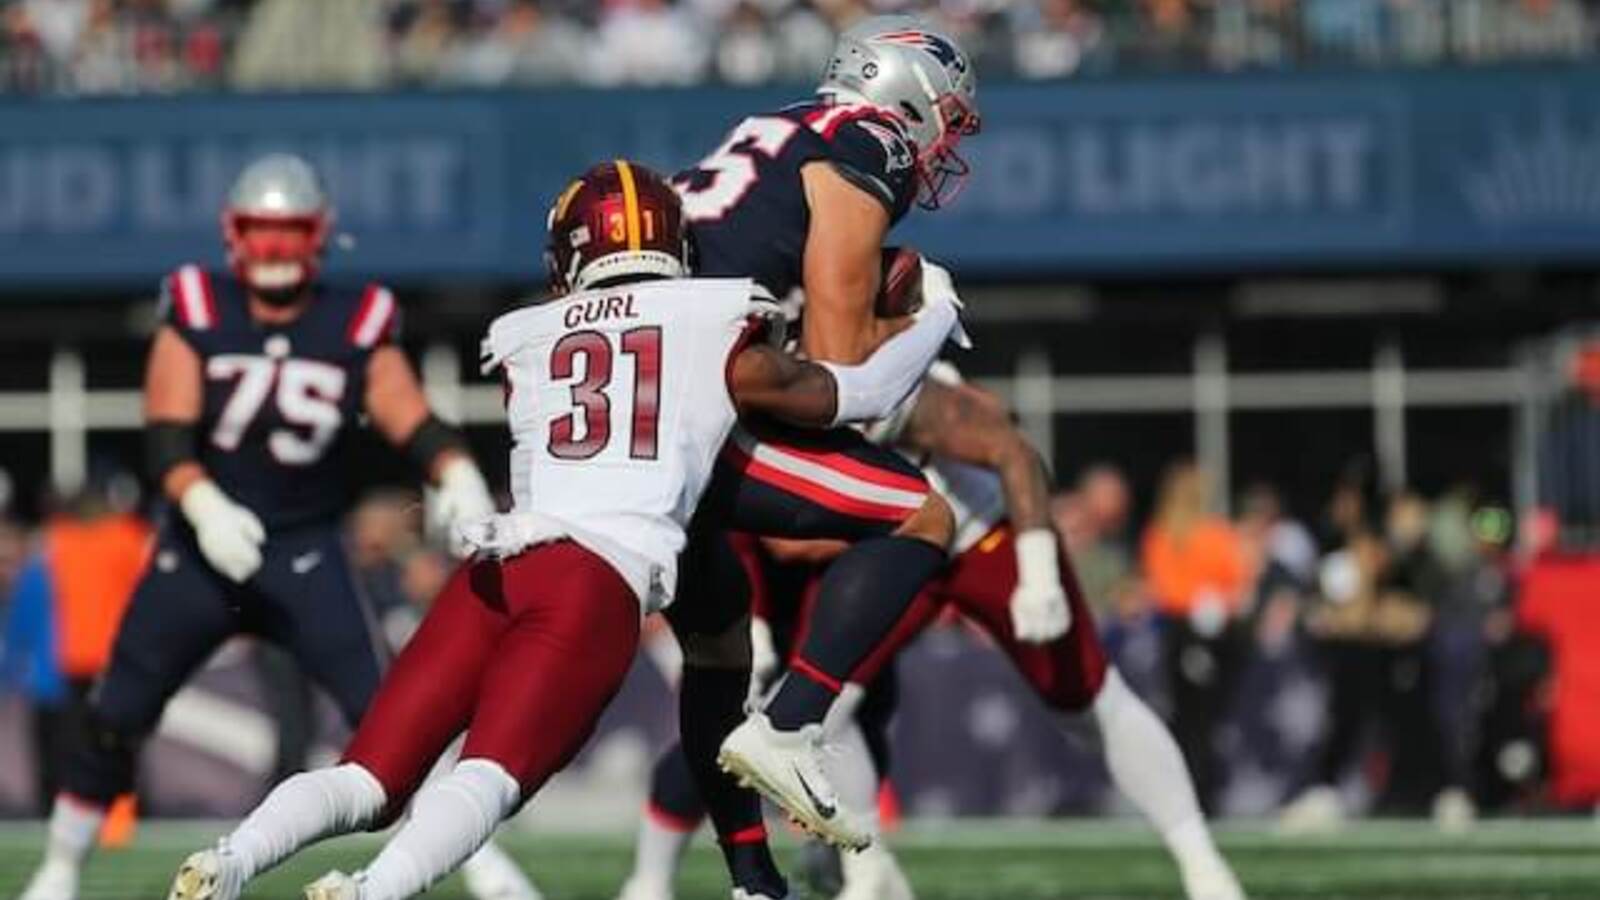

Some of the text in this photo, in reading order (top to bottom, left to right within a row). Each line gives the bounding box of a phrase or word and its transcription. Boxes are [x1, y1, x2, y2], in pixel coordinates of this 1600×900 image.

[563, 293, 640, 329] GURL
[206, 353, 347, 465] 75
[546, 325, 663, 461] 31
